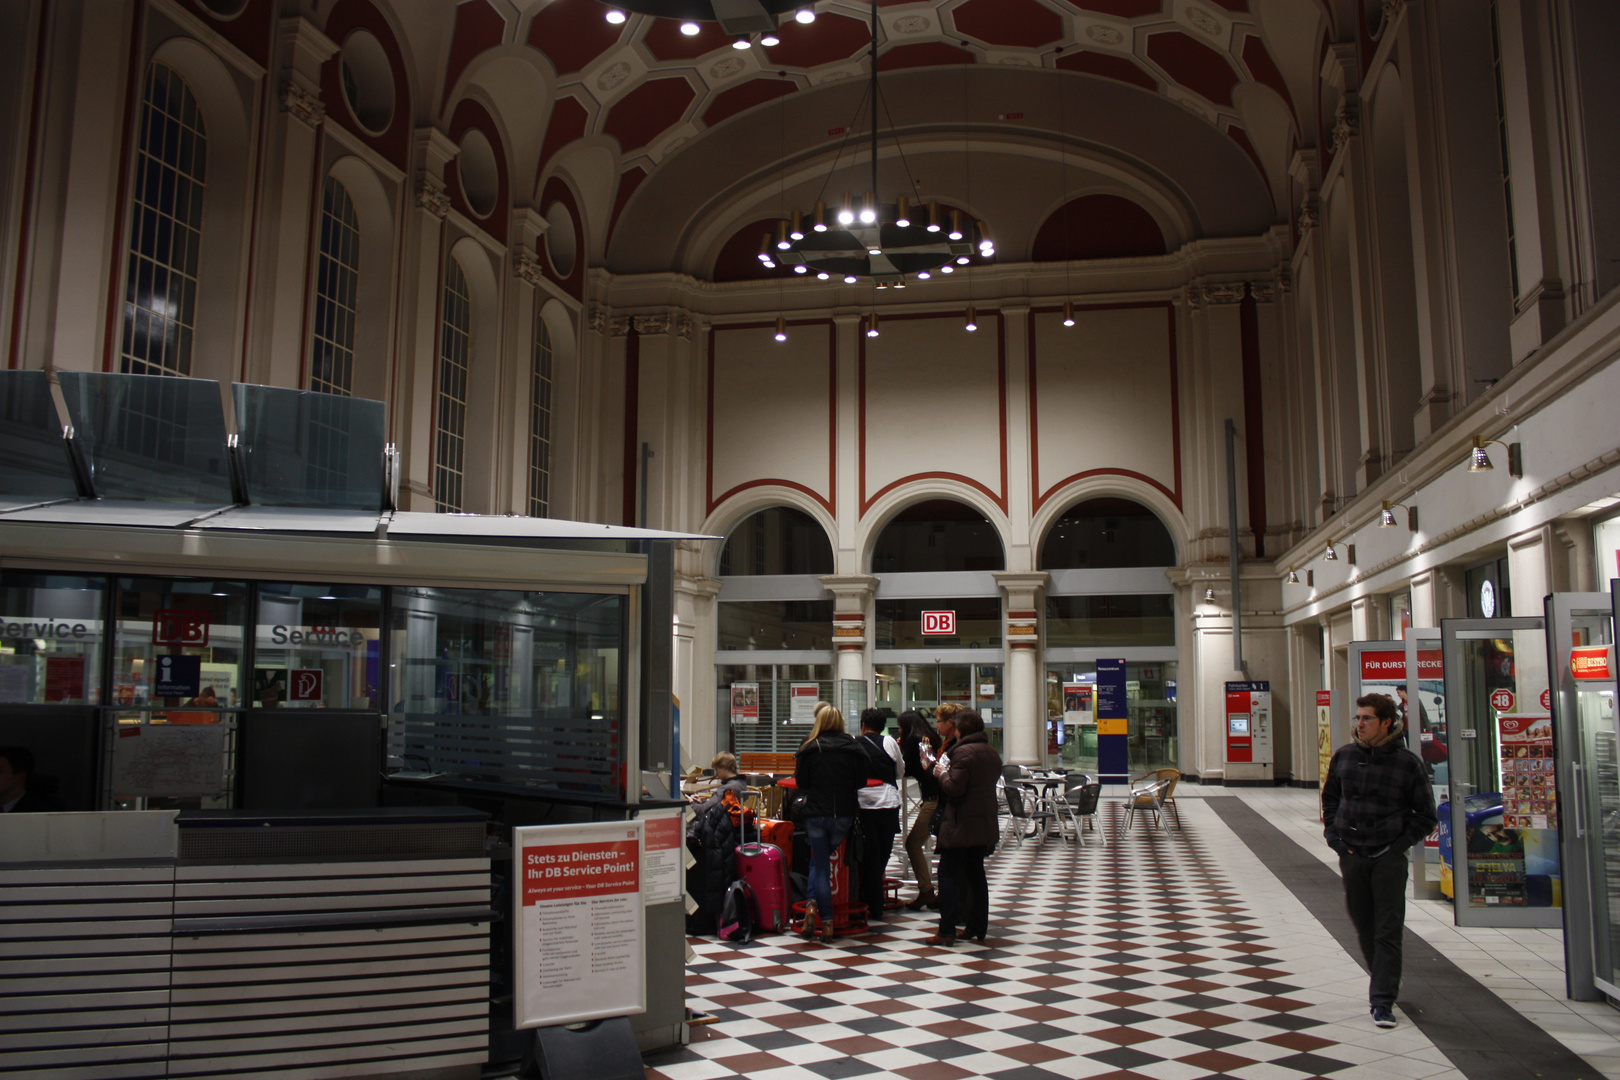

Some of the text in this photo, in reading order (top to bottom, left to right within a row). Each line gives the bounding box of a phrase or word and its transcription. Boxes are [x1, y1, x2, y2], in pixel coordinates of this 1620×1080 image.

[0, 617, 87, 638] ervice
[159, 614, 203, 642] DB
[925, 614, 952, 631] DB
[271, 624, 364, 646] Service
[1365, 660, 1381, 669] FÜR
[1495, 694, 1510, 707] 18
[527, 854, 556, 865] Stets
[557, 855, 570, 863] zu
[571, 850, 618, 862] Diensten
[527, 861, 635, 879] Ihr DB Service Point!
[1475, 862, 1517, 873] EFTELYA
